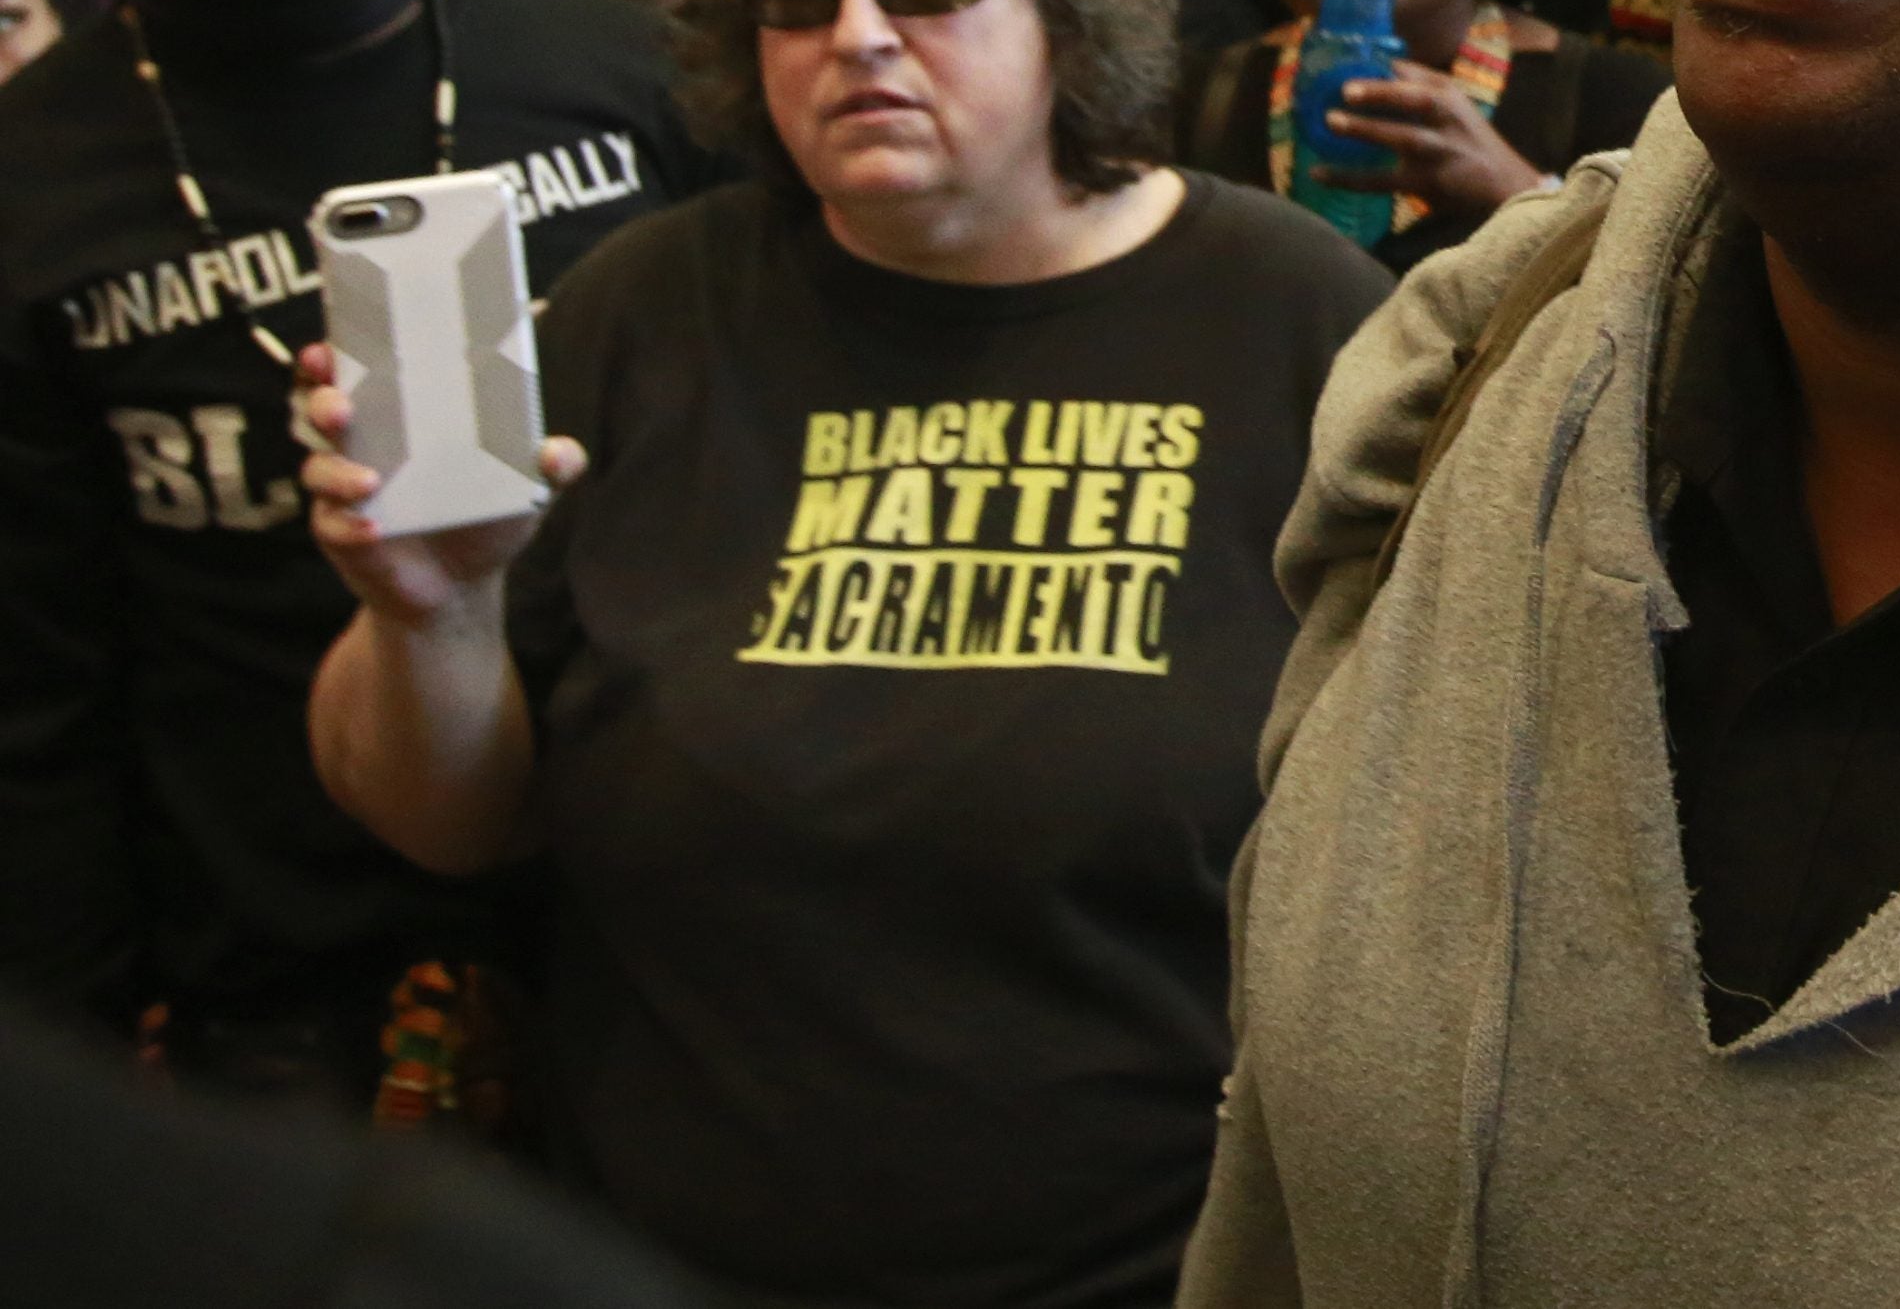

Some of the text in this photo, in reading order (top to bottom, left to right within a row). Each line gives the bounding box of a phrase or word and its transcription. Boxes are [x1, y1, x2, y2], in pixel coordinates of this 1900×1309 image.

[802, 400, 1205, 477] BLACK LIVES
[785, 467, 1196, 552] MATTER
[746, 556, 1176, 668] SACRAMENTO
